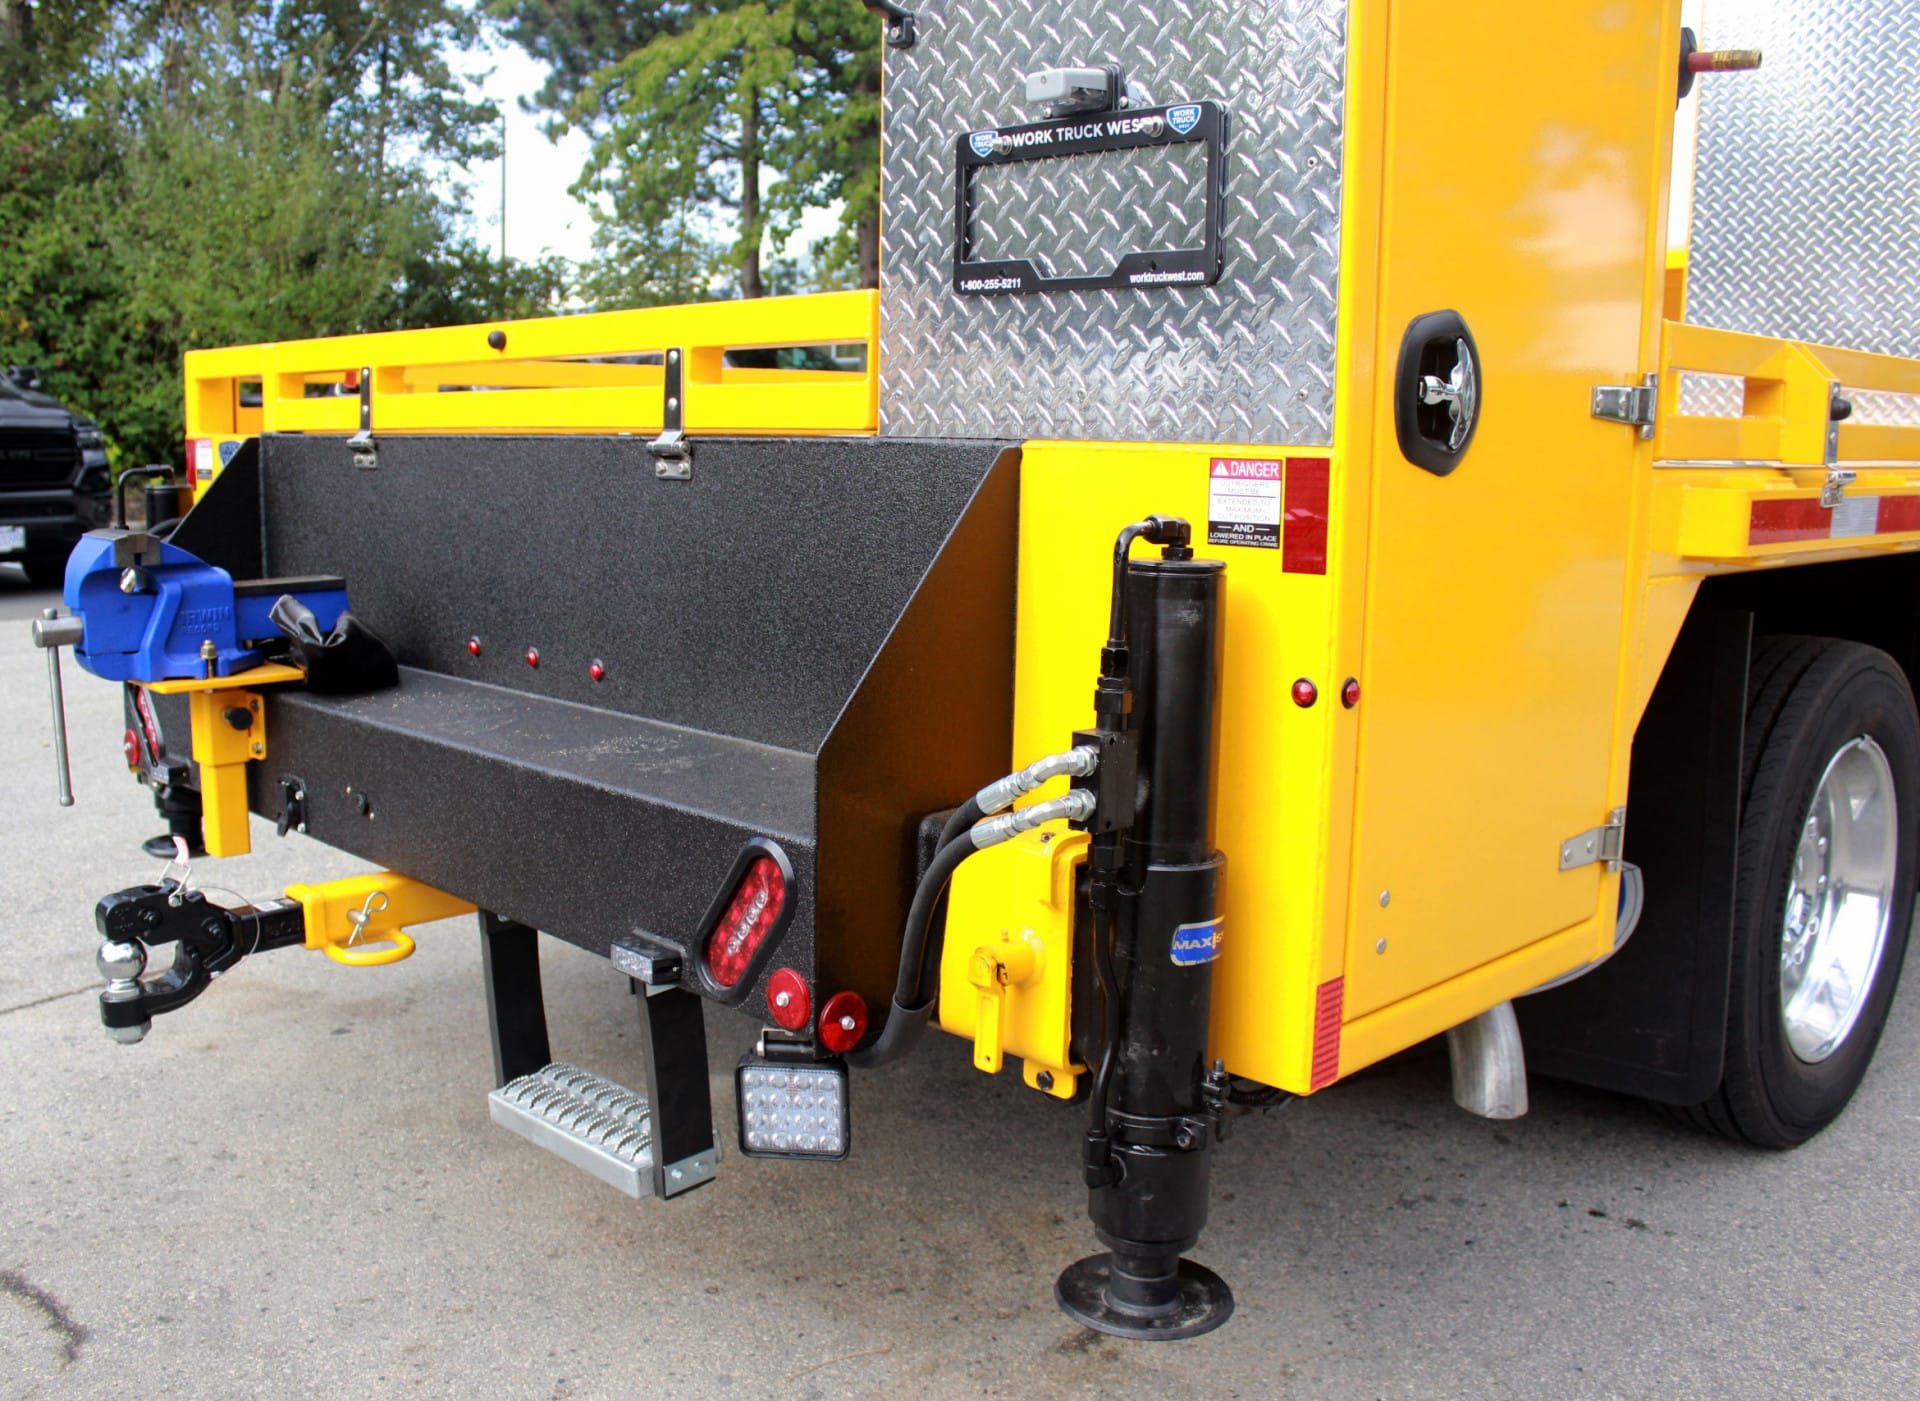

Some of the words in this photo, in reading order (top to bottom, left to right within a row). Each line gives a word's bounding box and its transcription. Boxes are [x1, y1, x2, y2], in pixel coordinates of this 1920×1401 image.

[1012, 130, 1053, 147] WORK
[1056, 122, 1104, 141] TRUCK
[1129, 271, 1204, 284] worktruckwest.com
[1230, 461, 1279, 477] DANGER
[1232, 523, 1255, 533] AND
[1209, 532, 1245, 540] LOWERED
[1245, 533, 1253, 541] IN
[1254, 534, 1277, 542] PLACE
